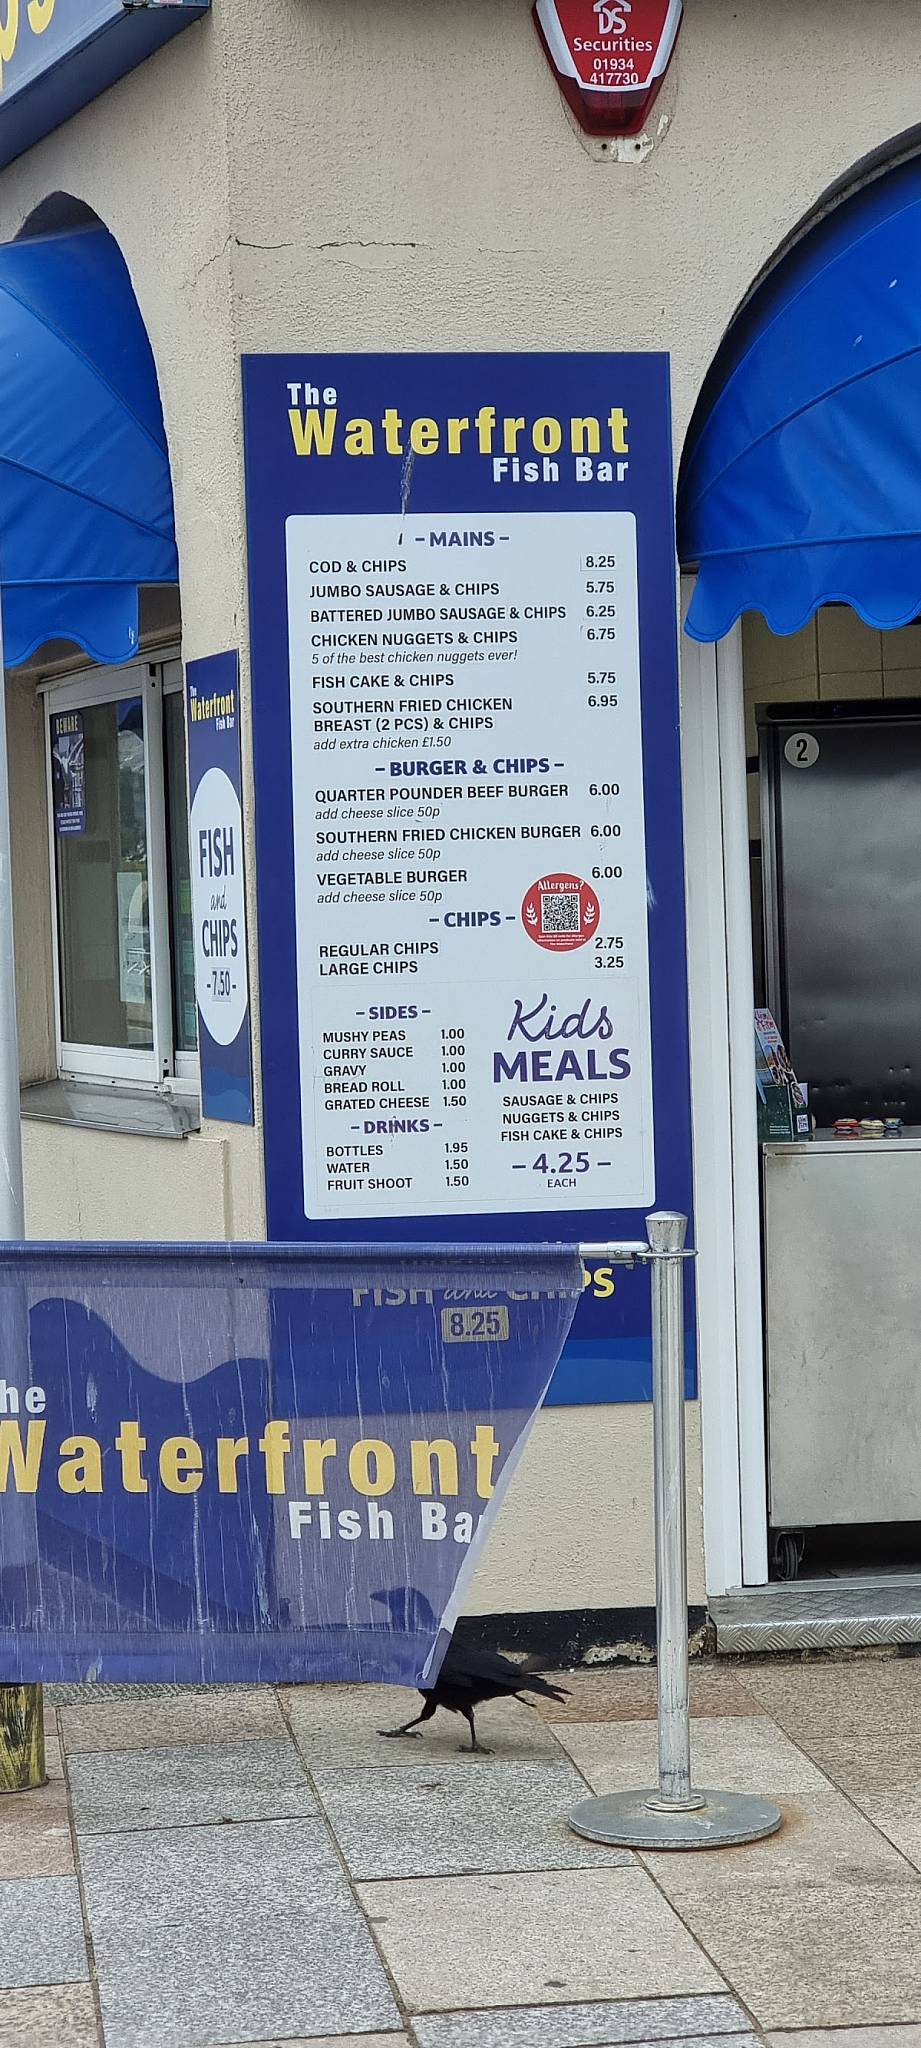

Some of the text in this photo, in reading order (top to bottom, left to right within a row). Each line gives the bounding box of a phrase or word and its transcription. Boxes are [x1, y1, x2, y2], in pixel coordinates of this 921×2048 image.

[599, 8, 626, 34] DS
[574, 37, 652, 51] Securities
[594, 58, 634, 70] 01934
[590, 73, 639, 84] 417730
[287, 383, 337, 405] The
[288, 407, 629, 455] Waterfront
[493, 457, 628, 482] Fish Bar
[430, 531, 495, 547] MAINS
[310, 560, 406, 573] COD & CHIPS
[586, 556, 615, 567] 8.25
[310, 583, 499, 598] JUMBO SAUSAGE & CHIPS
[586, 581, 614, 593] 5.75
[311, 607, 566, 622] BATTERED JUMBO SAUSAGE & CHIPS
[586, 606, 615, 617] 6.25
[311, 631, 517, 647] CHICKEN NUGGETS & CHIPS
[587, 628, 615, 640] 6.75
[312, 649, 517, 664] 5 of the best chicken nuggets ever!
[313, 674, 453, 688] FISH CAKE & CHIPS
[588, 672, 615, 684] 5.75
[190, 689, 235, 722] Waterfront
[313, 698, 512, 714] SOUTHERN FRIED CHICKEN
[588, 695, 617, 707] 6.95
[216, 717, 226, 731] Fish
[314, 717, 493, 732] BREAST (2 PCS) & CHIPS
[314, 736, 451, 750] add extra chicken £1.50
[796, 739, 808, 762] 2
[390, 758, 549, 776] BURGER & CHIPS
[315, 785, 568, 804] QUARTER POUNDER BEEF BURGER
[589, 784, 619, 795] 6.00
[315, 806, 440, 819] add cheese slice 50p
[317, 826, 580, 844] SOUTHERN FRIED CHICKEN BURGER
[591, 825, 620, 837] 6.00
[199, 827, 235, 878] FISH
[316, 848, 440, 861] add cheese slice 50p
[317, 870, 467, 886] VEGETABLE BURGER
[592, 866, 622, 878] 6.00
[538, 880, 584, 892] Allergens?
[210, 885, 228, 911] and
[317, 889, 442, 903] add cheese slice 50p
[444, 911, 501, 927] CHIPS
[202, 918, 238, 958] CHIPS
[595, 937, 623, 949] 2.75
[320, 942, 438, 957] REGULAR CHIPS
[320, 961, 418, 975] LARGE CHIPS
[595, 956, 623, 968] 3.25
[369, 1006, 418, 1020] SIDES
[507, 993, 613, 1042] Kids
[323, 1030, 405, 1043] MUSHY PEAS
[441, 1029, 464, 1039] 1.00
[323, 1047, 413, 1059] CURRY SAUCE
[442, 1045, 465, 1056] 1.00
[324, 1065, 366, 1076] GRAVY
[442, 1062, 465, 1073] 1.00
[494, 1048, 631, 1083] MEALS
[325, 1081, 405, 1093] BREAD ROLL
[442, 1079, 466, 1090] 1.00
[325, 1097, 429, 1110] GRATED CHEESE
[443, 1096, 466, 1106] 1.50
[503, 1093, 618, 1106] SAUSAGE & CHIPS
[503, 1110, 619, 1124] NUGGETS & CHIPS
[364, 1119, 429, 1134] DRINKS
[501, 1128, 622, 1141] FISH CAKE & CHIPS
[327, 1145, 383, 1157] BOTTLES
[445, 1142, 468, 1153] 1.95
[327, 1162, 369, 1173] WATER
[445, 1159, 468, 1169] 1.50
[533, 1152, 589, 1173] 4.25
[328, 1178, 412, 1190] FRUIT SHOOT
[446, 1176, 469, 1186] 1.50
[548, 1178, 576, 1188] EACH
[450, 1312, 501, 1337] 8.25
[0, 1379, 47, 1414] he
[0, 1420, 499, 1499] Waterfront
[289, 1502, 484, 1544] Fish Ba
